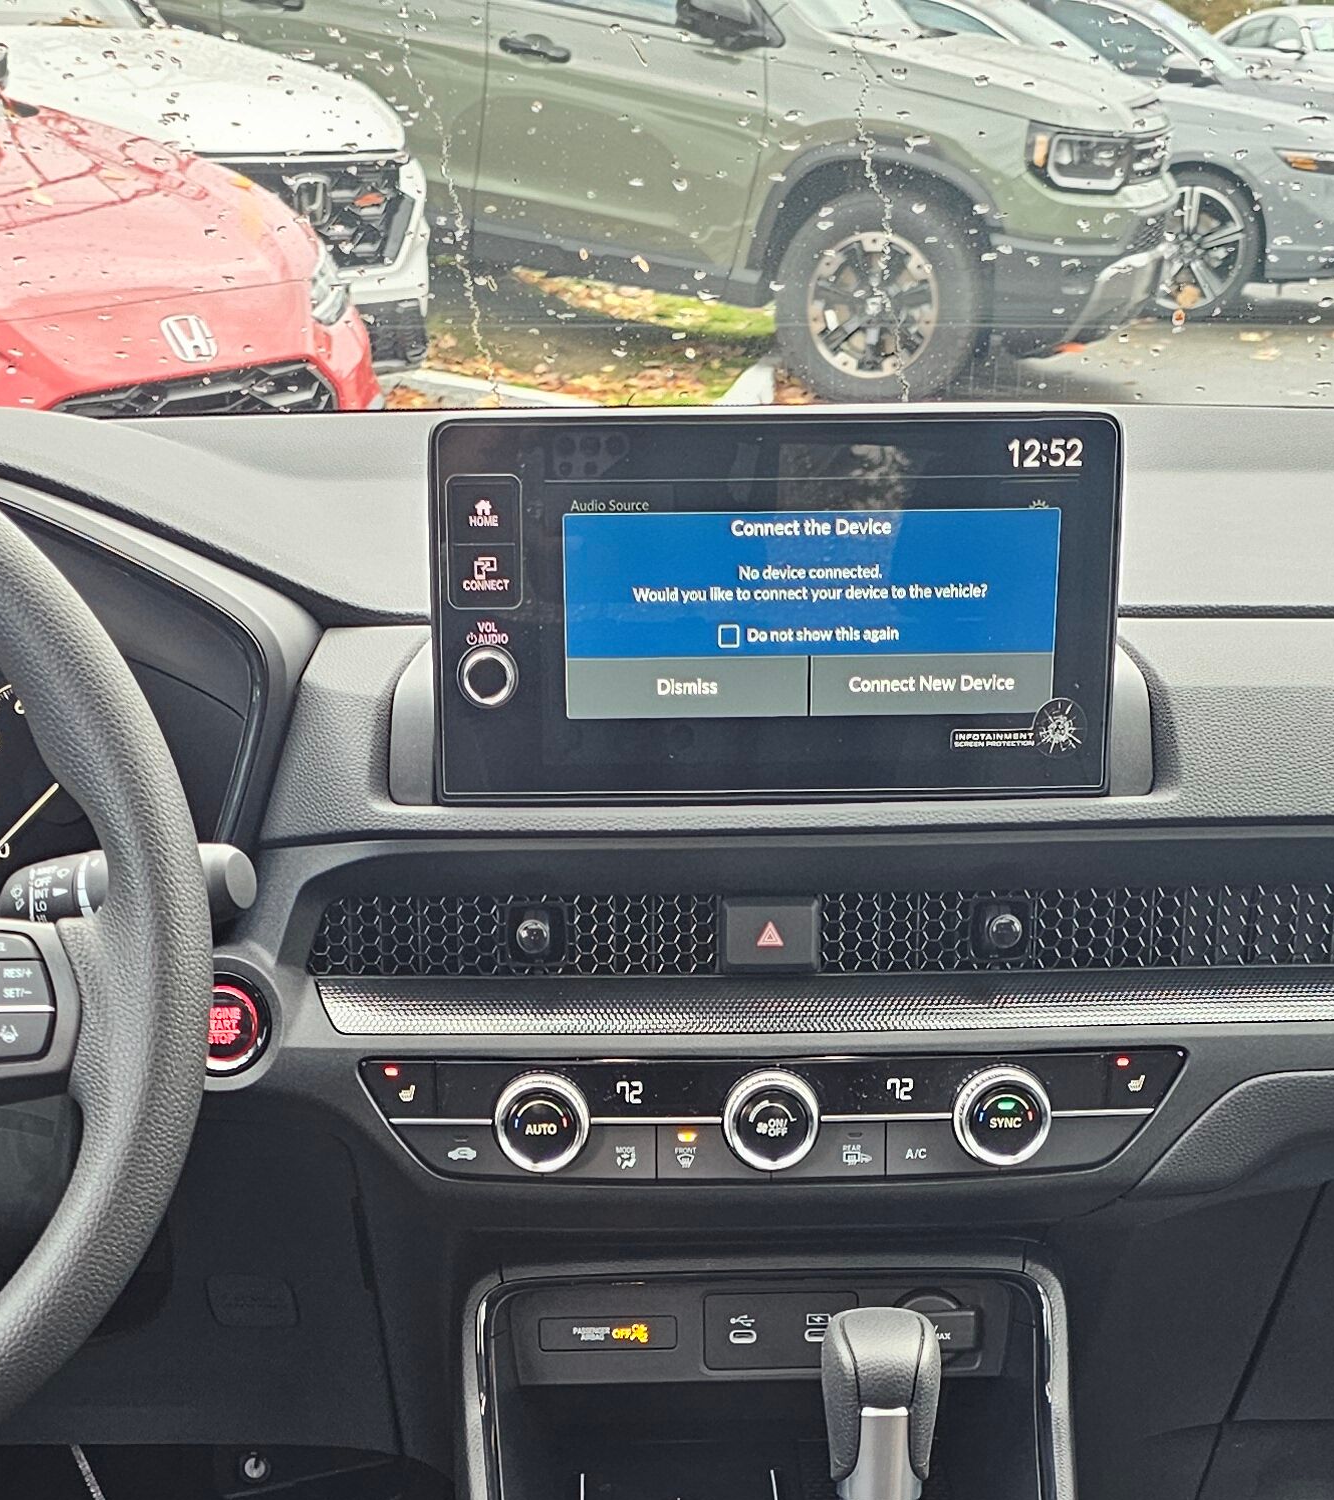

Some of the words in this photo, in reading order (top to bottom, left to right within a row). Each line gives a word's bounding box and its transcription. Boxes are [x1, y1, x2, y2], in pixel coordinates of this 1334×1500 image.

[1008, 438, 1083, 468] 12:52
[571, 500, 606, 512] Audio
[609, 500, 650, 512] Source
[469, 515, 498, 527] HOME
[730, 519, 801, 537] Connect
[804, 519, 831, 536] the
[835, 518, 892, 536] Device
[738, 566, 759, 580] No
[762, 565, 806, 580] device
[809, 564, 883, 580] connected.
[462, 579, 510, 591] CONNECT
[633, 587, 679, 602] Would
[682, 590, 706, 604] you
[710, 587, 734, 601] like
[736, 588, 750, 601] to
[754, 587, 808, 601] connect
[810, 589, 843, 603] your
[845, 585, 888, 600] device
[891, 586, 906, 599] to
[909, 584, 932, 599] the
[934, 583, 988, 599] vehicle?
[477, 622, 497, 633] VOL
[478, 633, 509, 644] AUDIO
[747, 628, 768, 643] Do
[770, 627, 793, 642] not
[796, 627, 833, 642] show
[835, 626, 860, 641] this
[863, 626, 899, 644] again
[657, 678, 718, 695] Dismiss
[848, 676, 916, 693] Connect
[919, 676, 956, 692] New
[960, 674, 1015, 691] Device
[955, 733, 1034, 741] INFOTAINMENT
[34, 876, 52, 888] OFF
[35, 888, 49, 899] INT
[34, 900, 47, 912] LO
[3, 968, 33, 979] RES/+
[209, 1020, 238, 1031] TART
[616, 1080, 644, 1105] 72
[886, 1078, 914, 1101] 72
[989, 1117, 1022, 1129] SYNC
[525, 1123, 557, 1136] AUTO
[768, 1127, 788, 1137] OFF
[615, 1146, 636, 1154] MODE
[675, 1147, 697, 1155] FRONT
[905, 1148, 927, 1160] A/C
[612, 1327, 632, 1339] OFF
